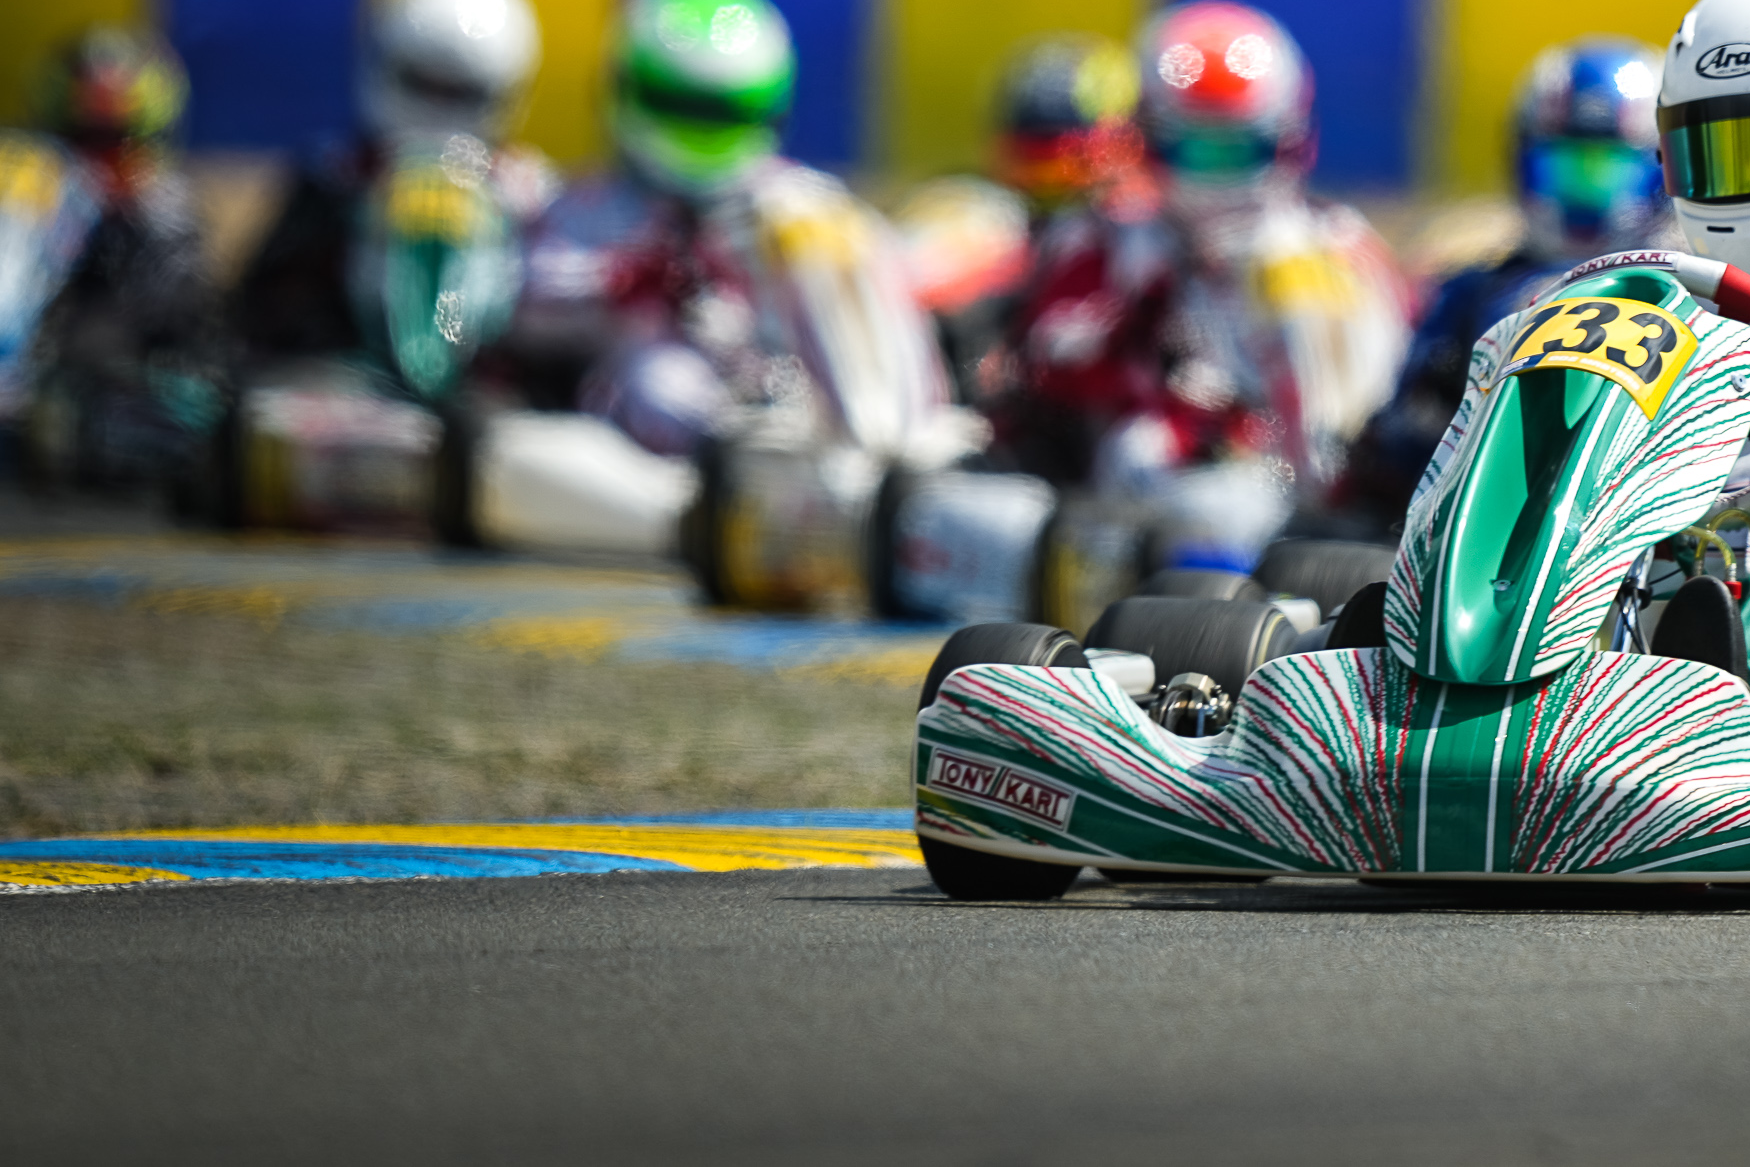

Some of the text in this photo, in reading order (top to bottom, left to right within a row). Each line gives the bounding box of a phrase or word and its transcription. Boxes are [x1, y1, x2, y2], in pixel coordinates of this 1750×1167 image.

[1510, 301, 1678, 385] 733
[936, 752, 1070, 818] TONY KART
